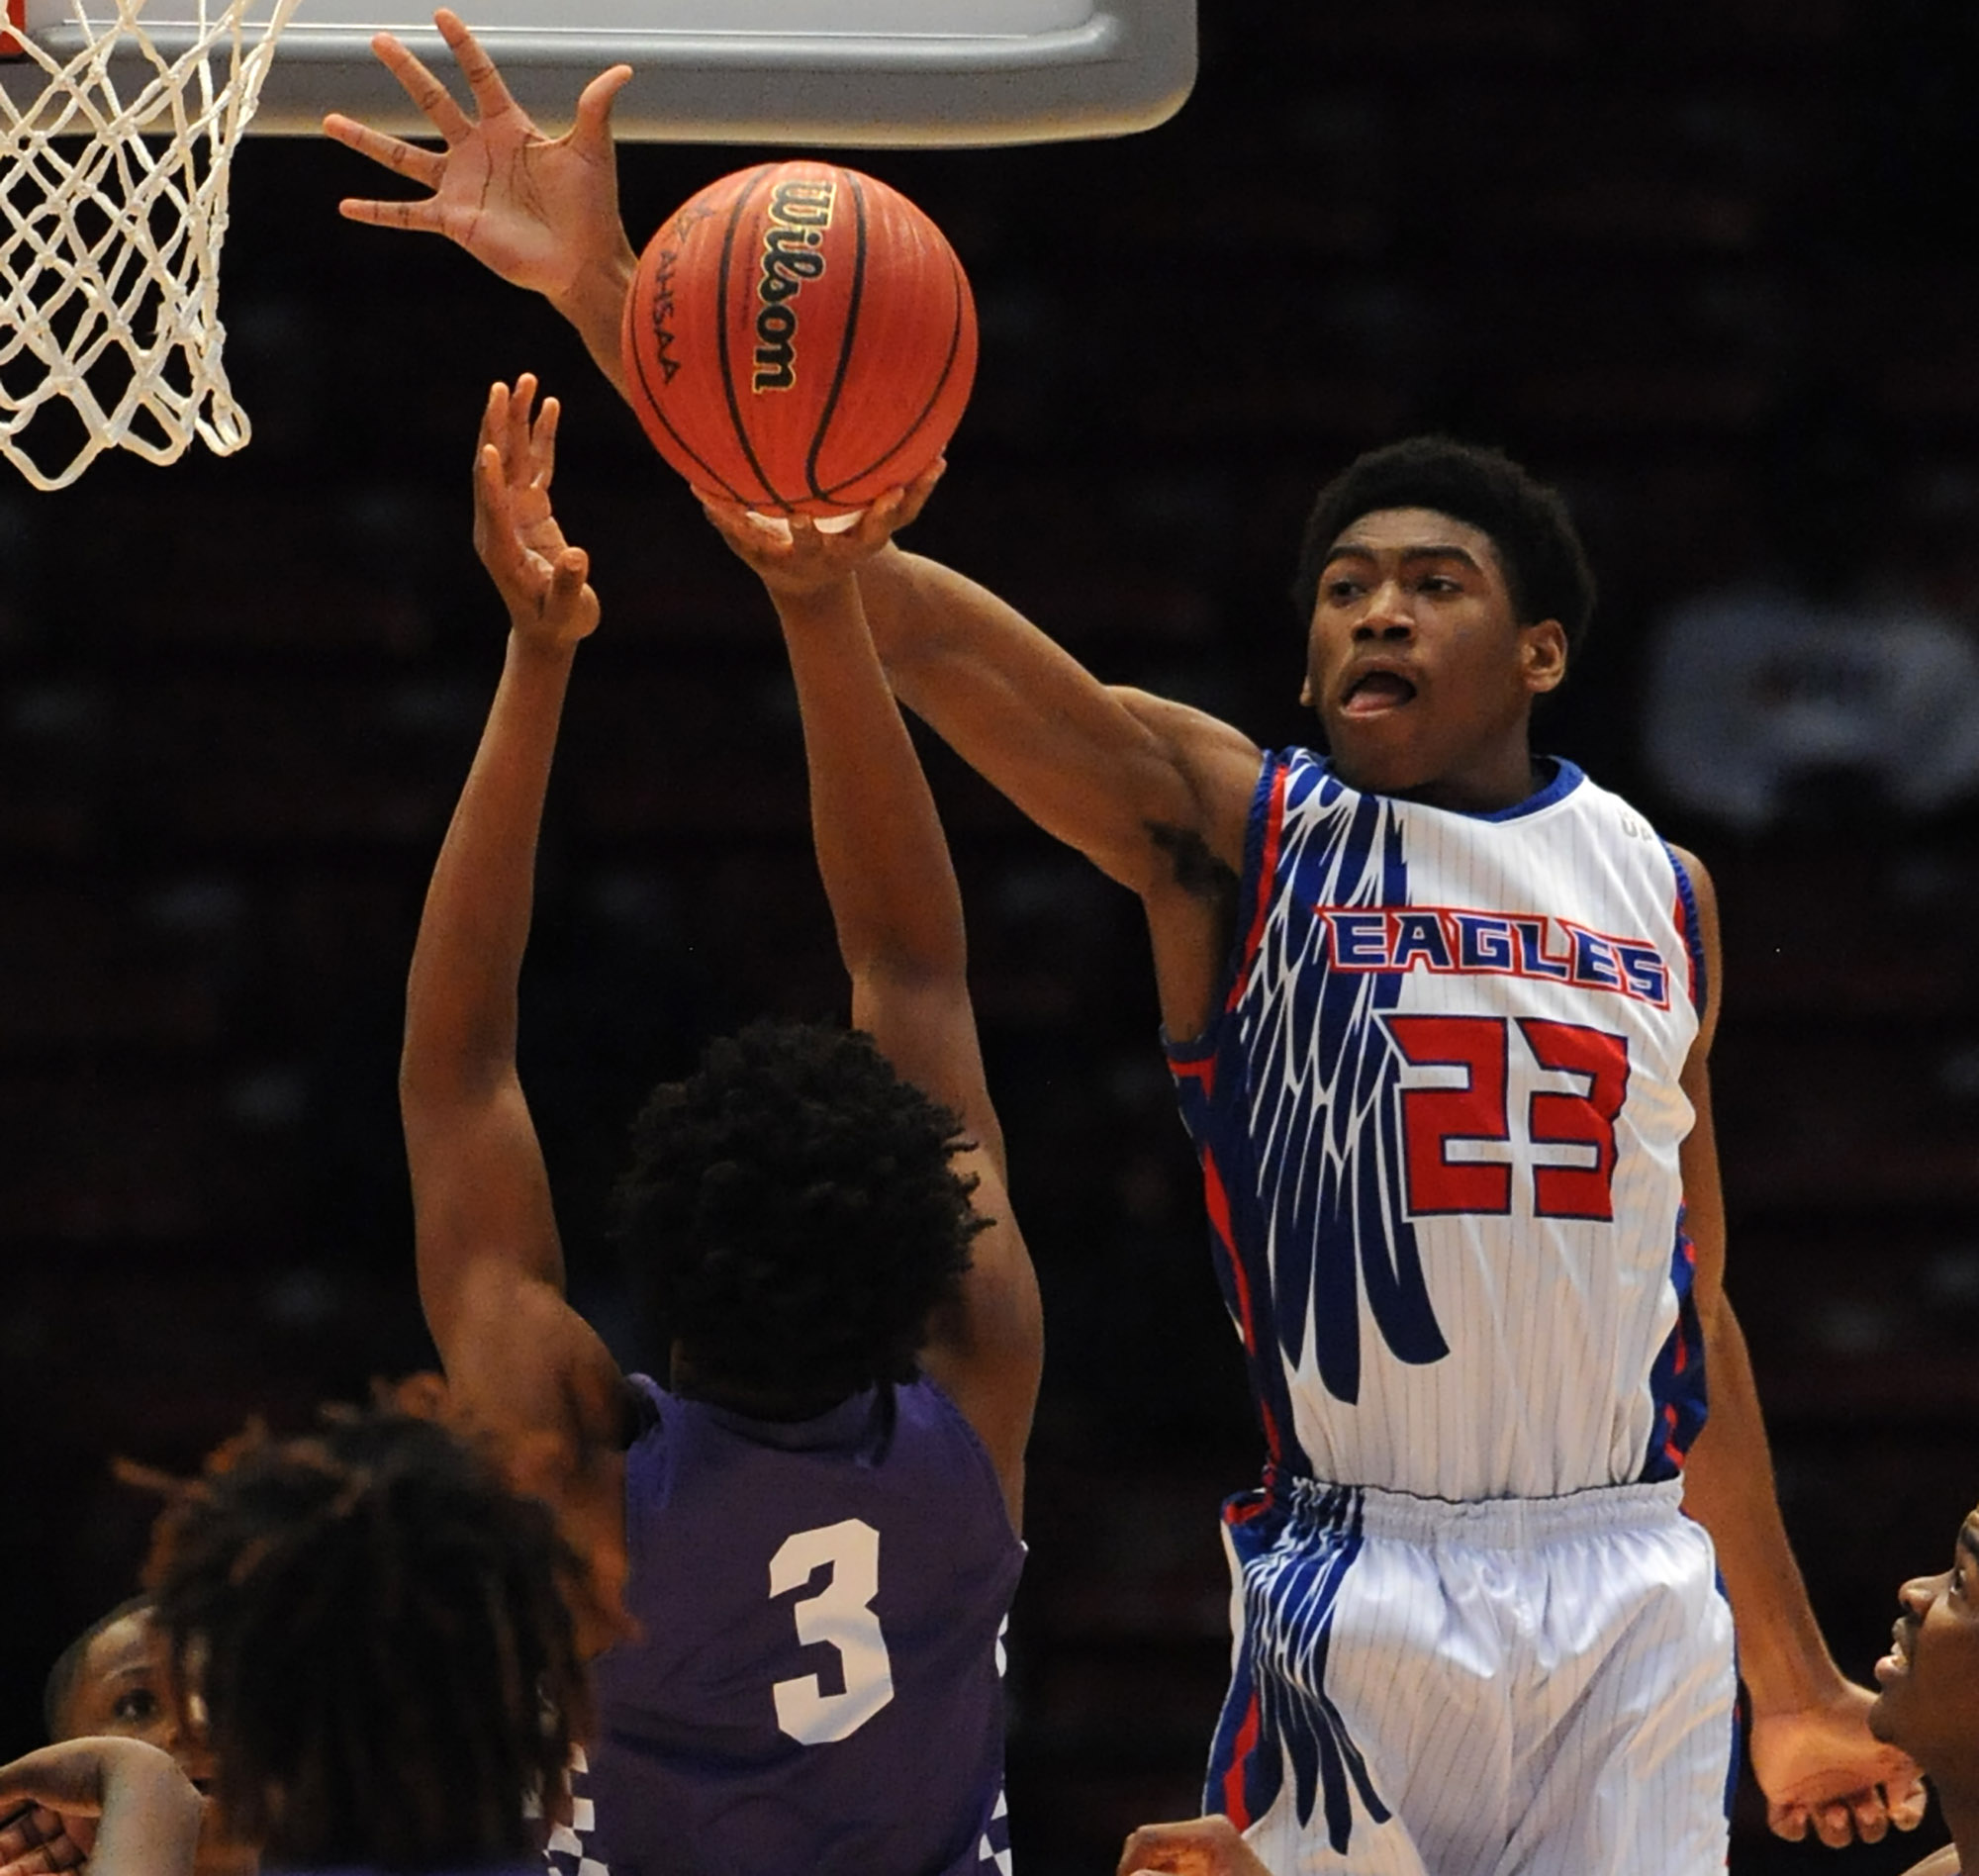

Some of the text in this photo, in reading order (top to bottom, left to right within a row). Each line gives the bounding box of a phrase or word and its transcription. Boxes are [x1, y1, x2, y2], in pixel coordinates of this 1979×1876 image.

[652, 249, 682, 386] AHSAA
[753, 180, 837, 394] Wilson
[1316, 906, 1670, 1010] EAGLES
[1384, 1013, 1632, 1222] 23
[769, 1518, 895, 1746] 3
